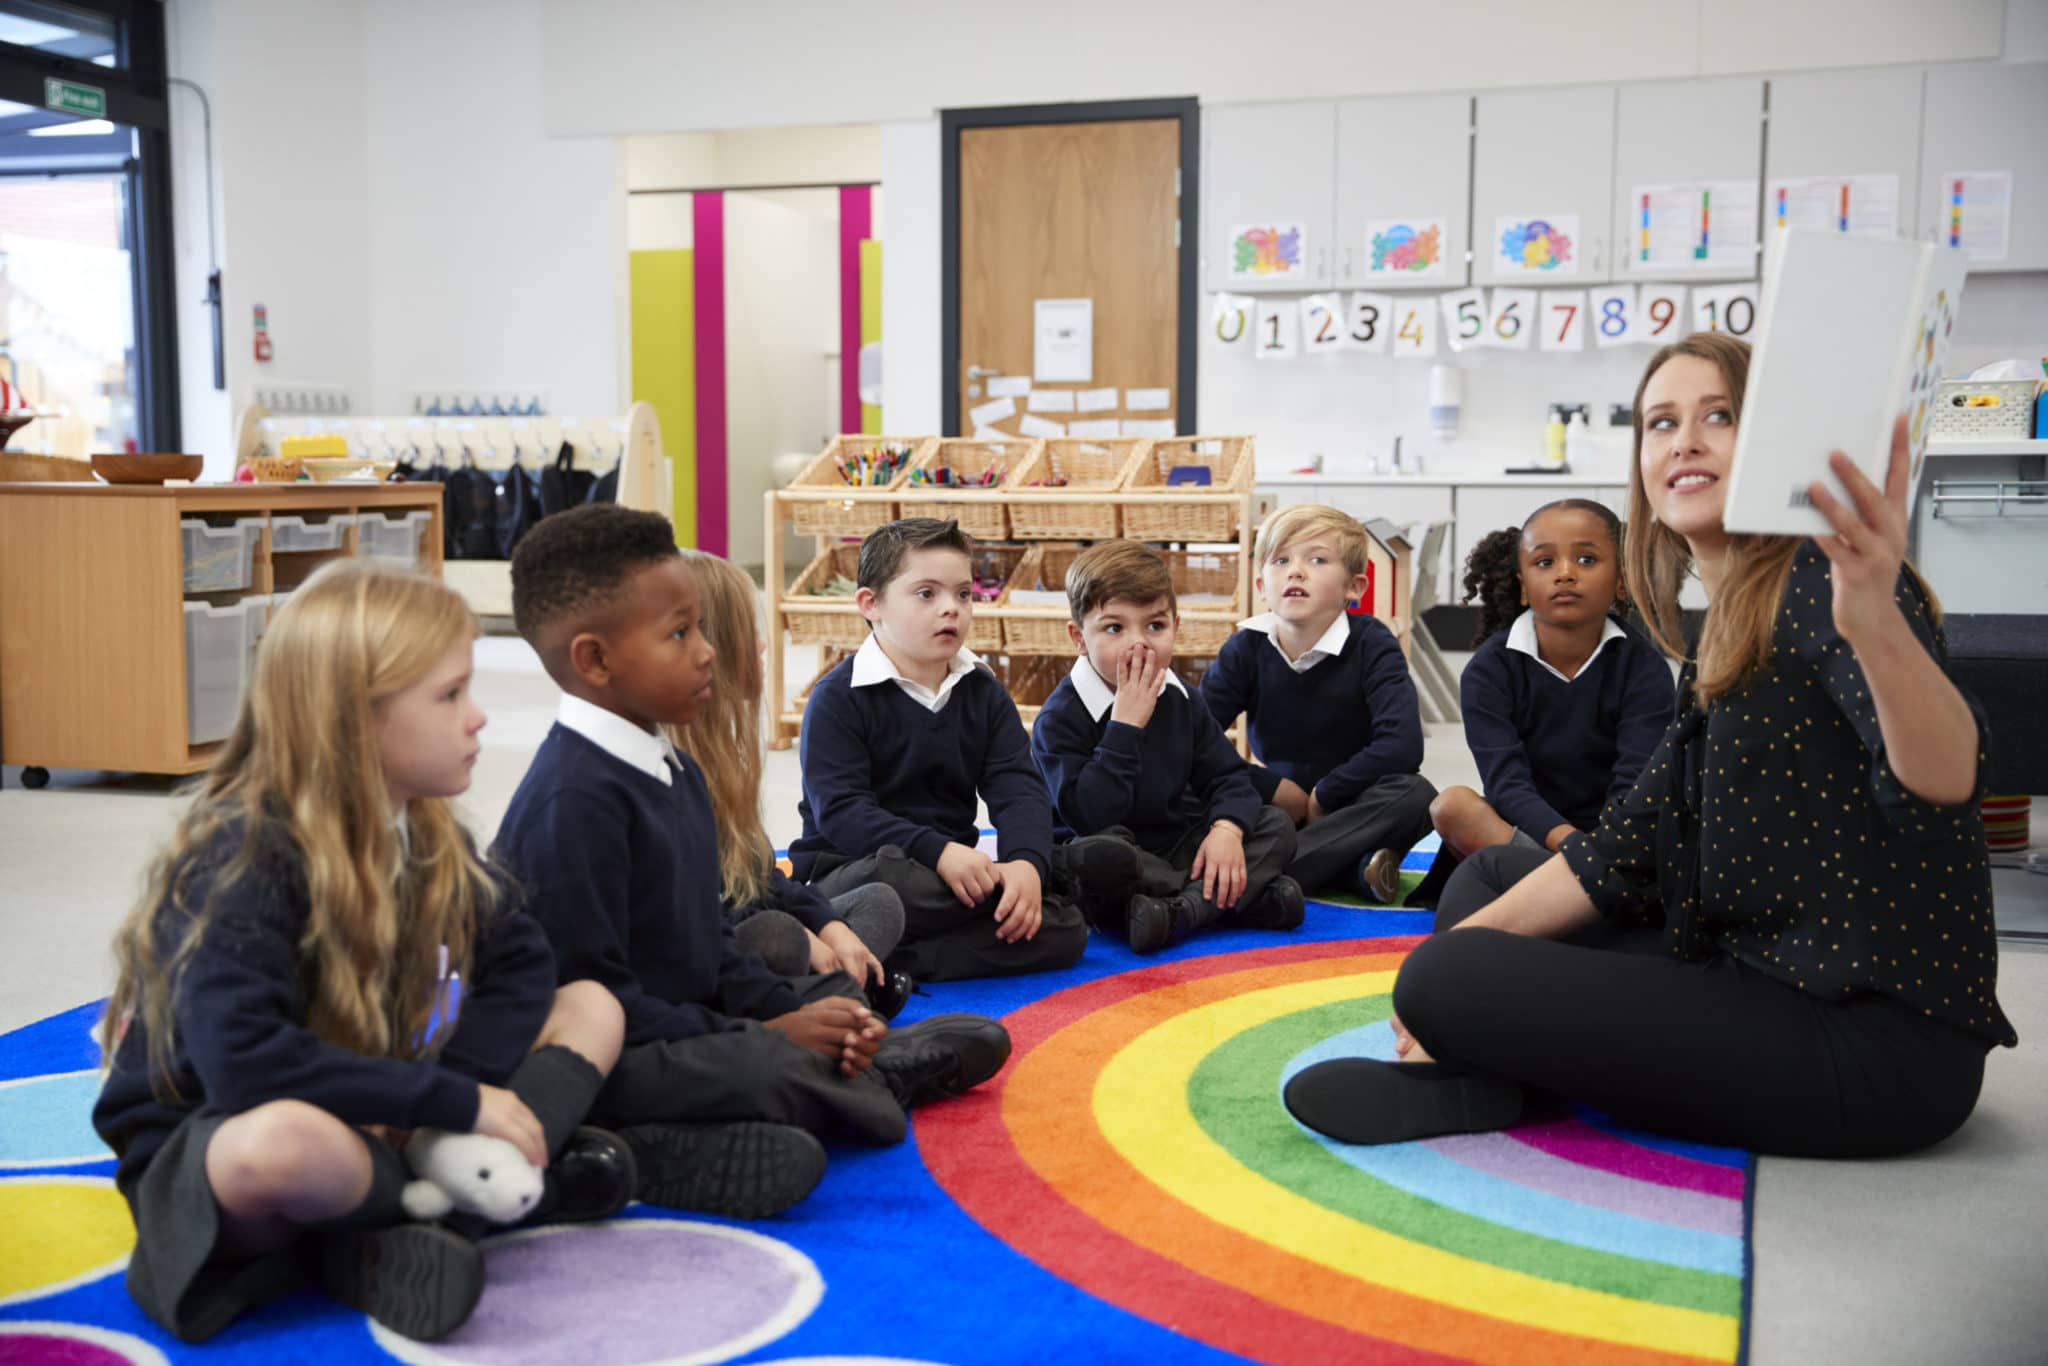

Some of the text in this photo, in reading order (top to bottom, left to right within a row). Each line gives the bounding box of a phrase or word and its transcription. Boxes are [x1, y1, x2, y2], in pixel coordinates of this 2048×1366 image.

[1217, 296, 1756, 349] 0 1 2 3 4 5 6 7 8 9 10
